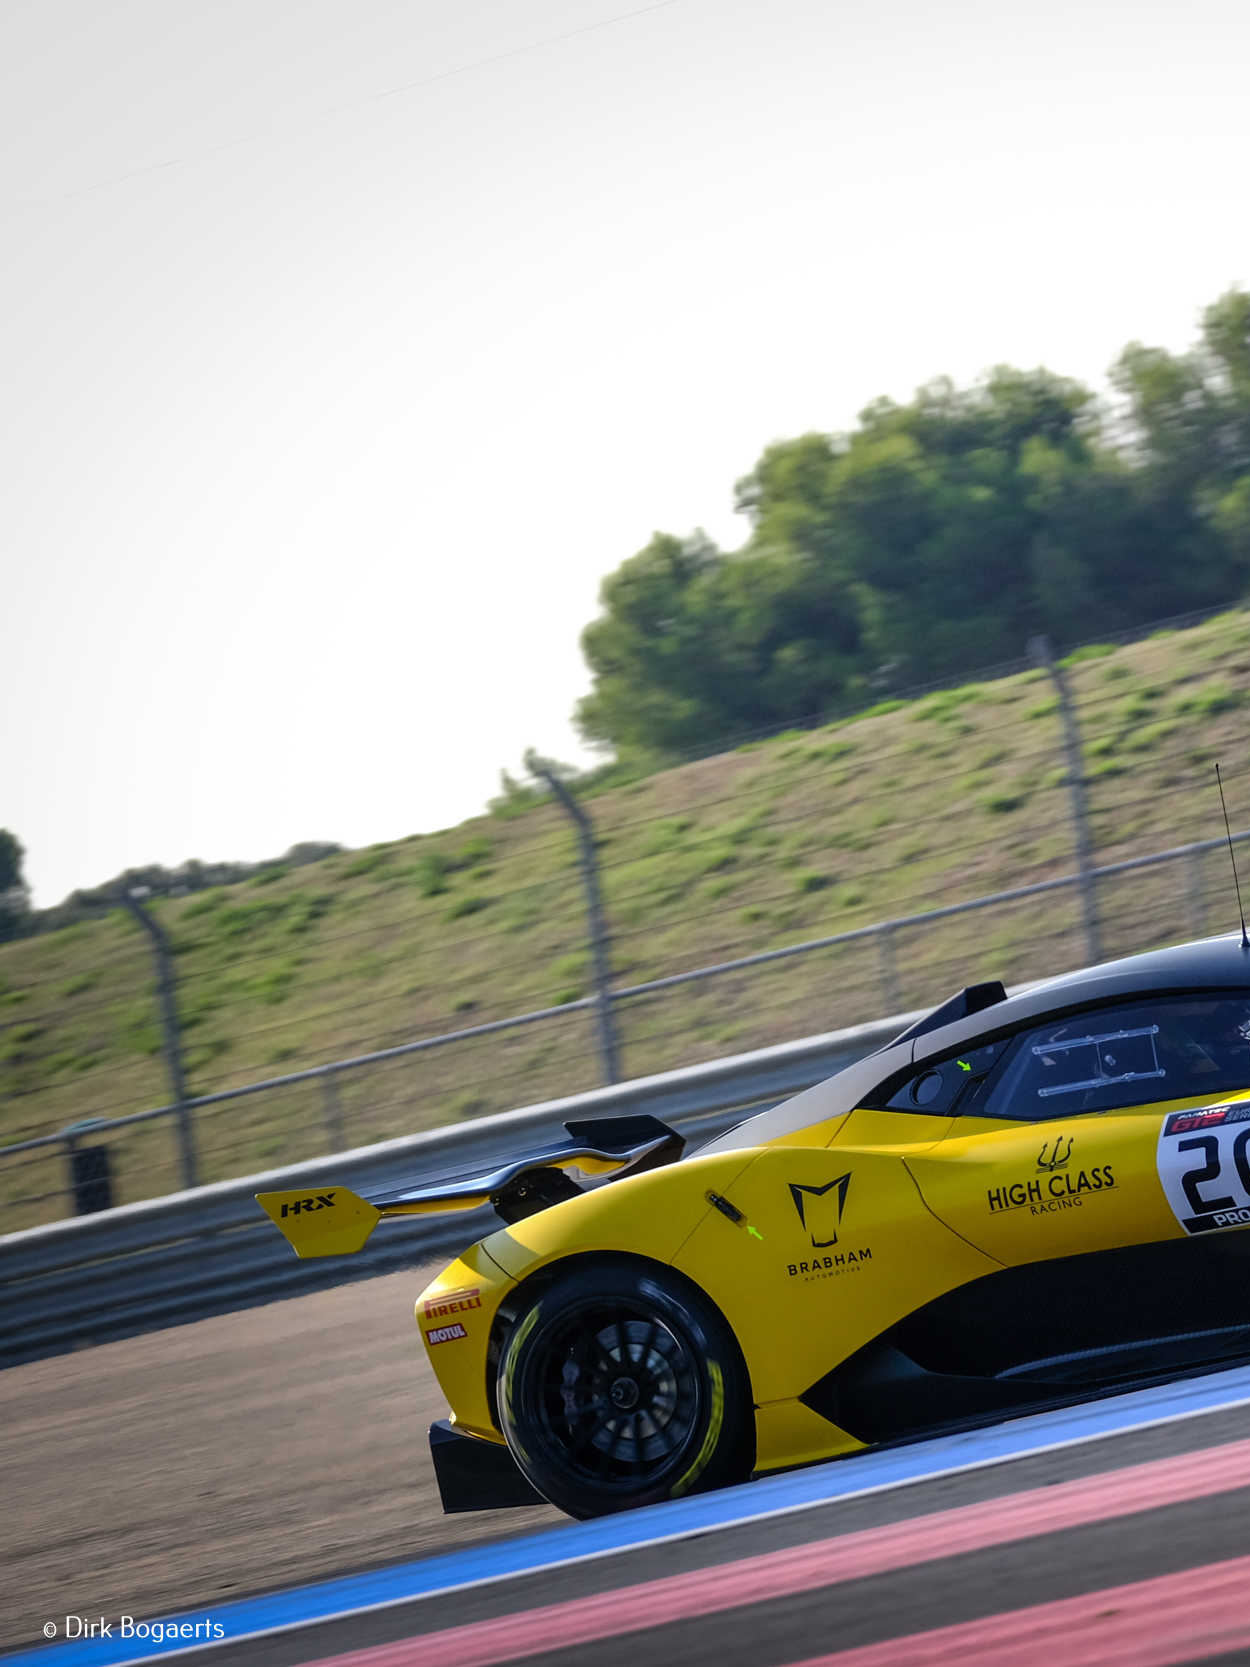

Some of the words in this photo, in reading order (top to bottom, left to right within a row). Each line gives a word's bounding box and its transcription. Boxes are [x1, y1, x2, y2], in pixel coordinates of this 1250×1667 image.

[987, 1180, 1042, 1211] HIGH
[1048, 1165, 1115, 1197] CLASS
[281, 1191, 336, 1218] HRX
[1030, 1197, 1082, 1216] RACING
[787, 1247, 873, 1276] BRABHAM
[424, 1288, 482, 1319] PIRELLI
[428, 1324, 466, 1345] MOTUL
